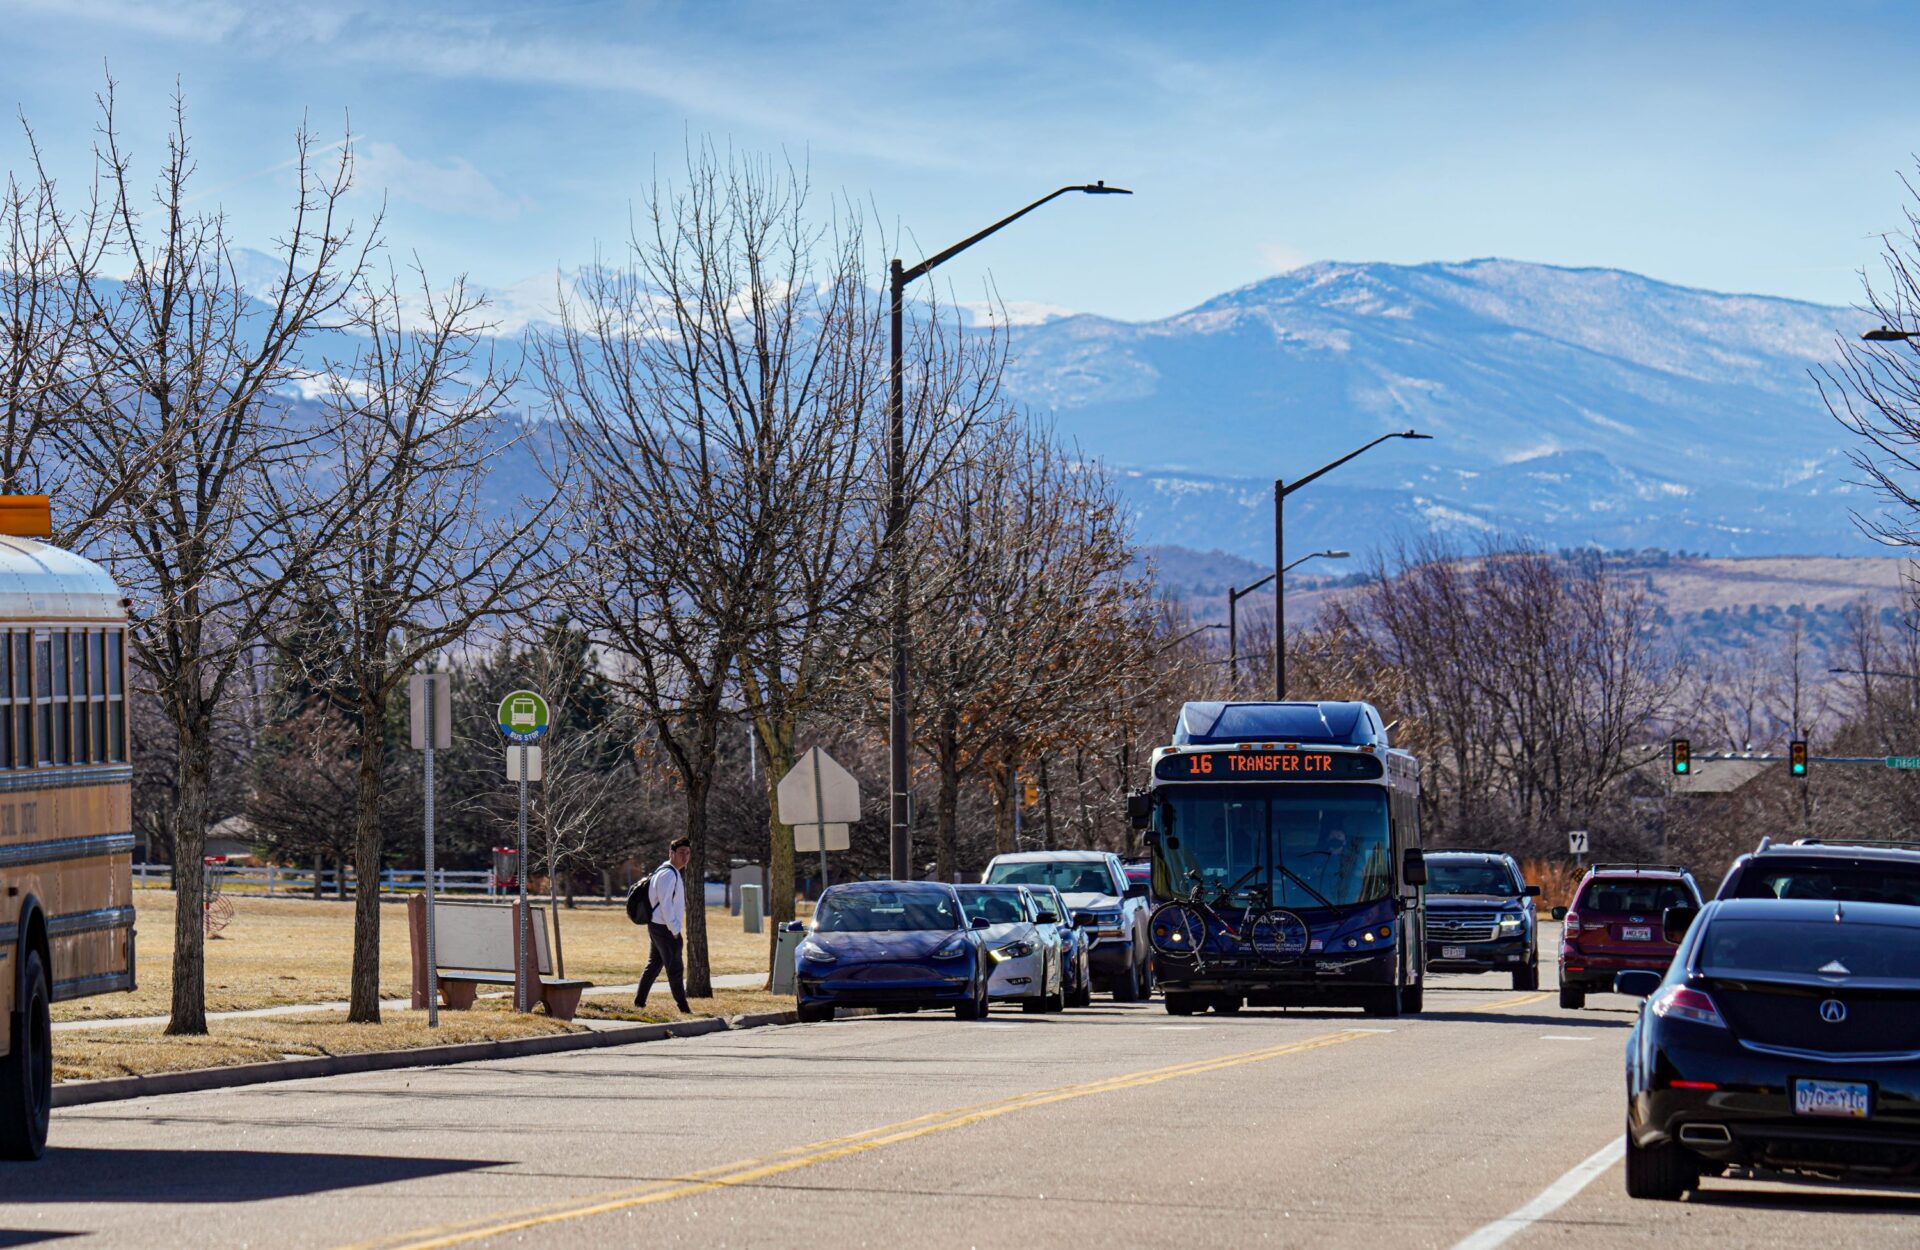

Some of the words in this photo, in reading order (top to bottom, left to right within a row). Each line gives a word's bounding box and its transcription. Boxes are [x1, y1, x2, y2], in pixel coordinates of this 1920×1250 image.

[509, 731, 523, 741] BUS
[524, 730, 540, 741] STOP
[1189, 754, 1213, 774] 16
[1228, 755, 1300, 771] TRANSFER
[1304, 755, 1332, 771] CTR
